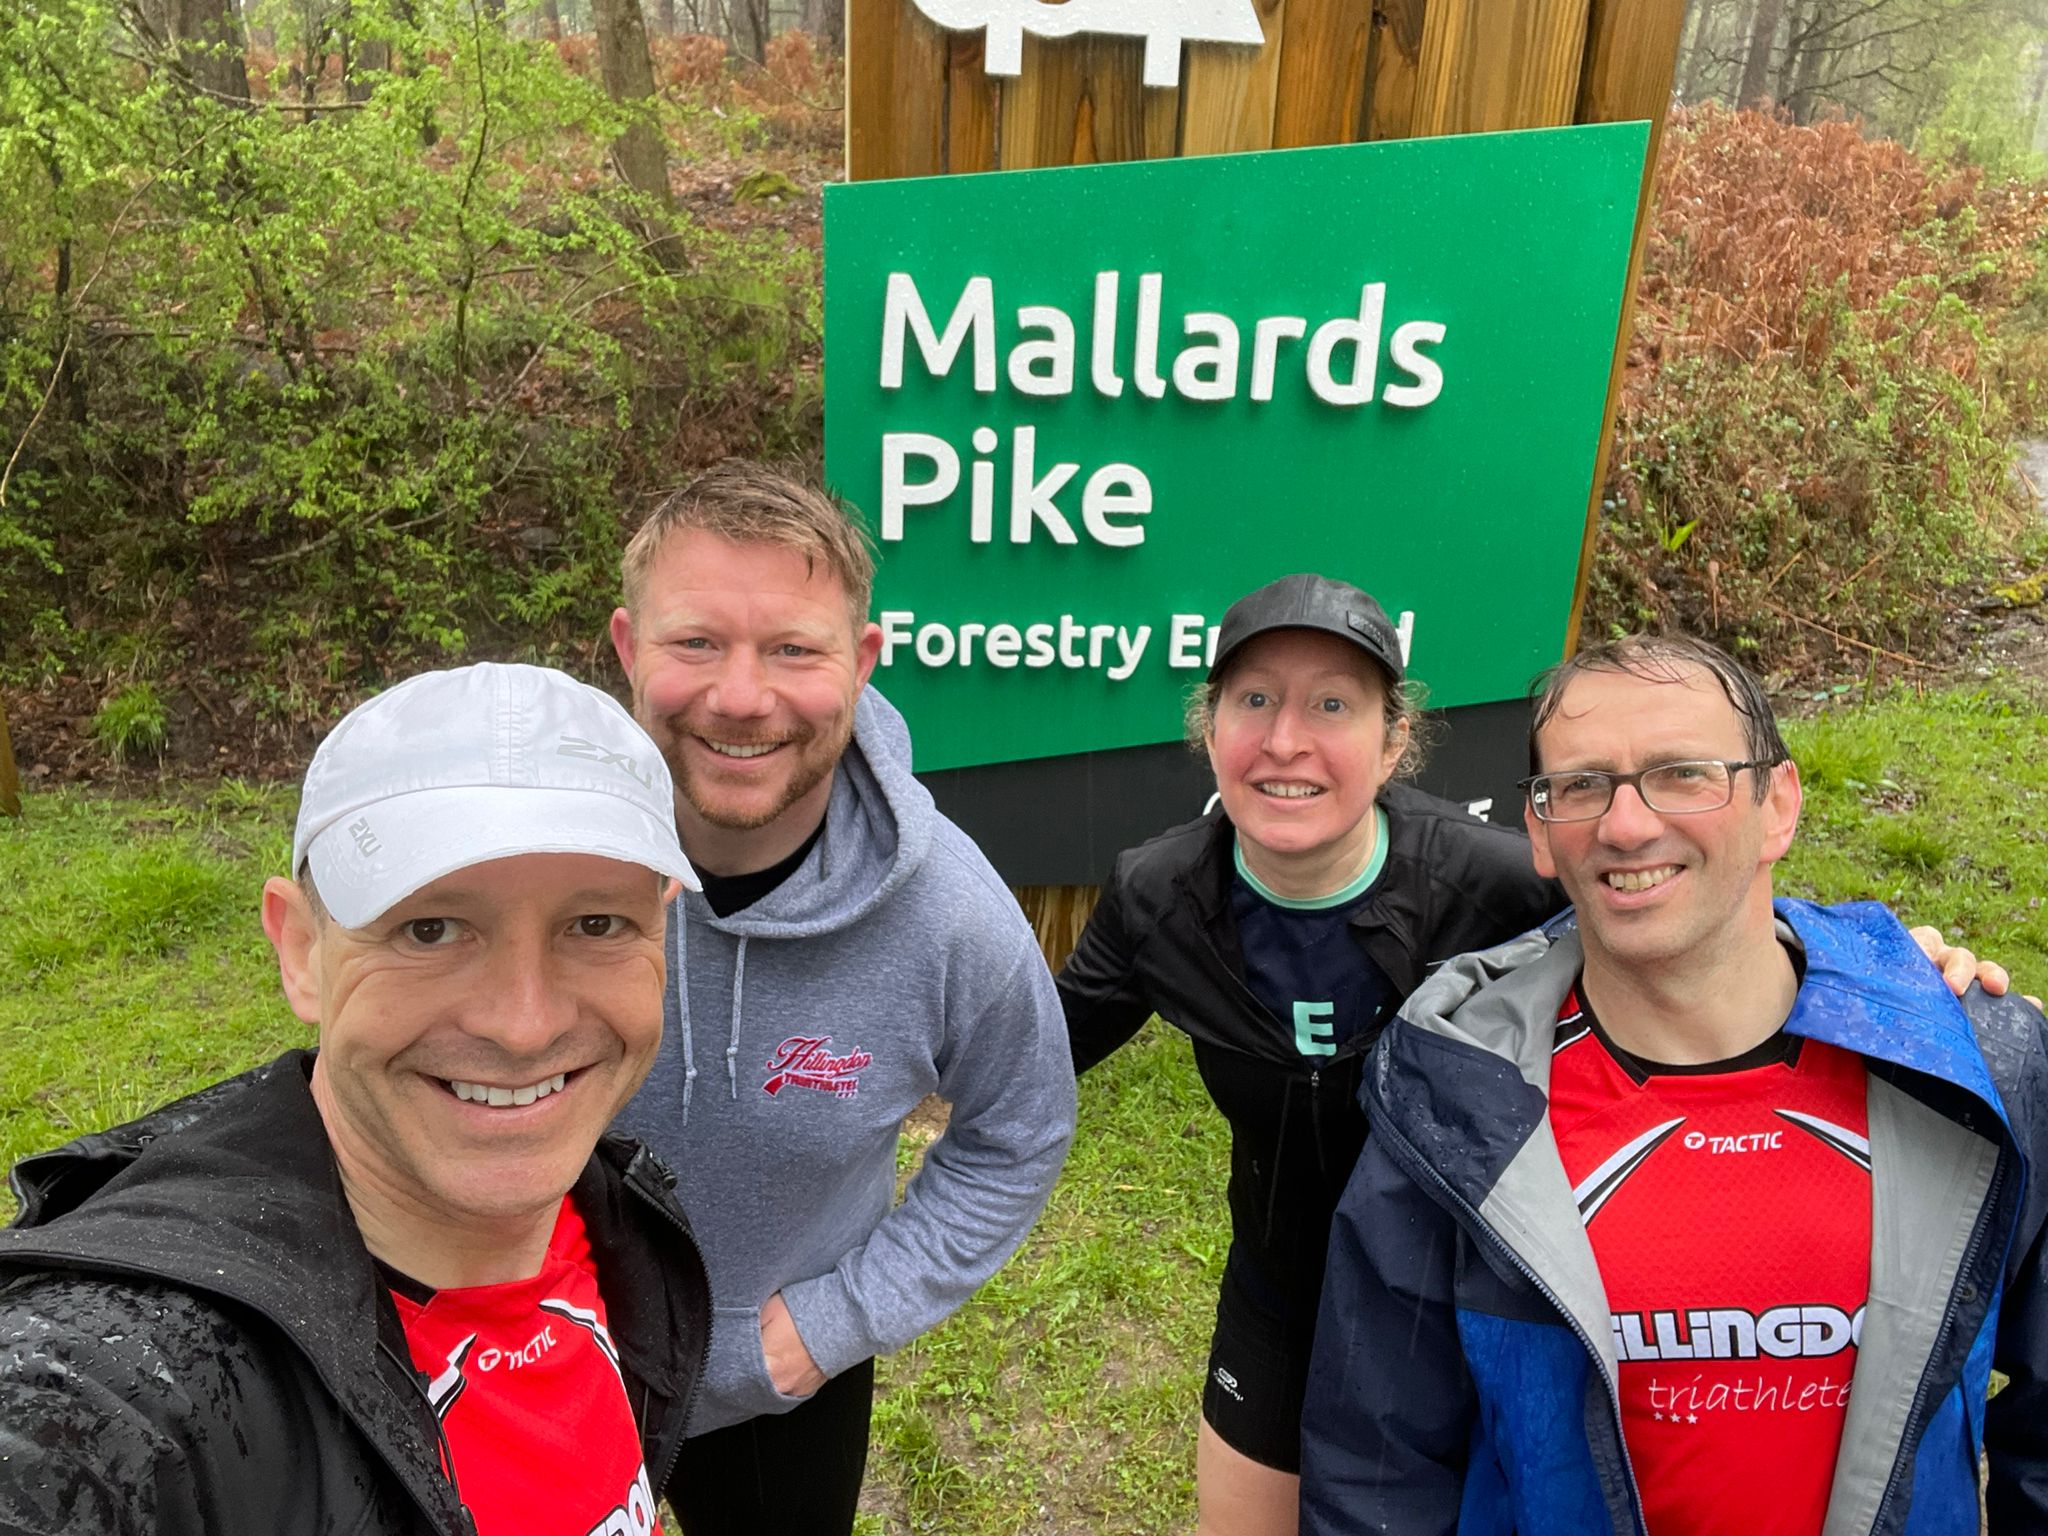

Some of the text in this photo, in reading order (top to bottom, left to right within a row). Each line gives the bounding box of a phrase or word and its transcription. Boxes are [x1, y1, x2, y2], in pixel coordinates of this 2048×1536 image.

[880, 271, 1447, 408] Mallards
[881, 425, 1153, 547] Pike
[880, 611, 1151, 680] Forestry
[348, 817, 382, 857] 2XU
[766, 1036, 873, 1079] Hillingdon
[1709, 1131, 1783, 1154] TACTIC
